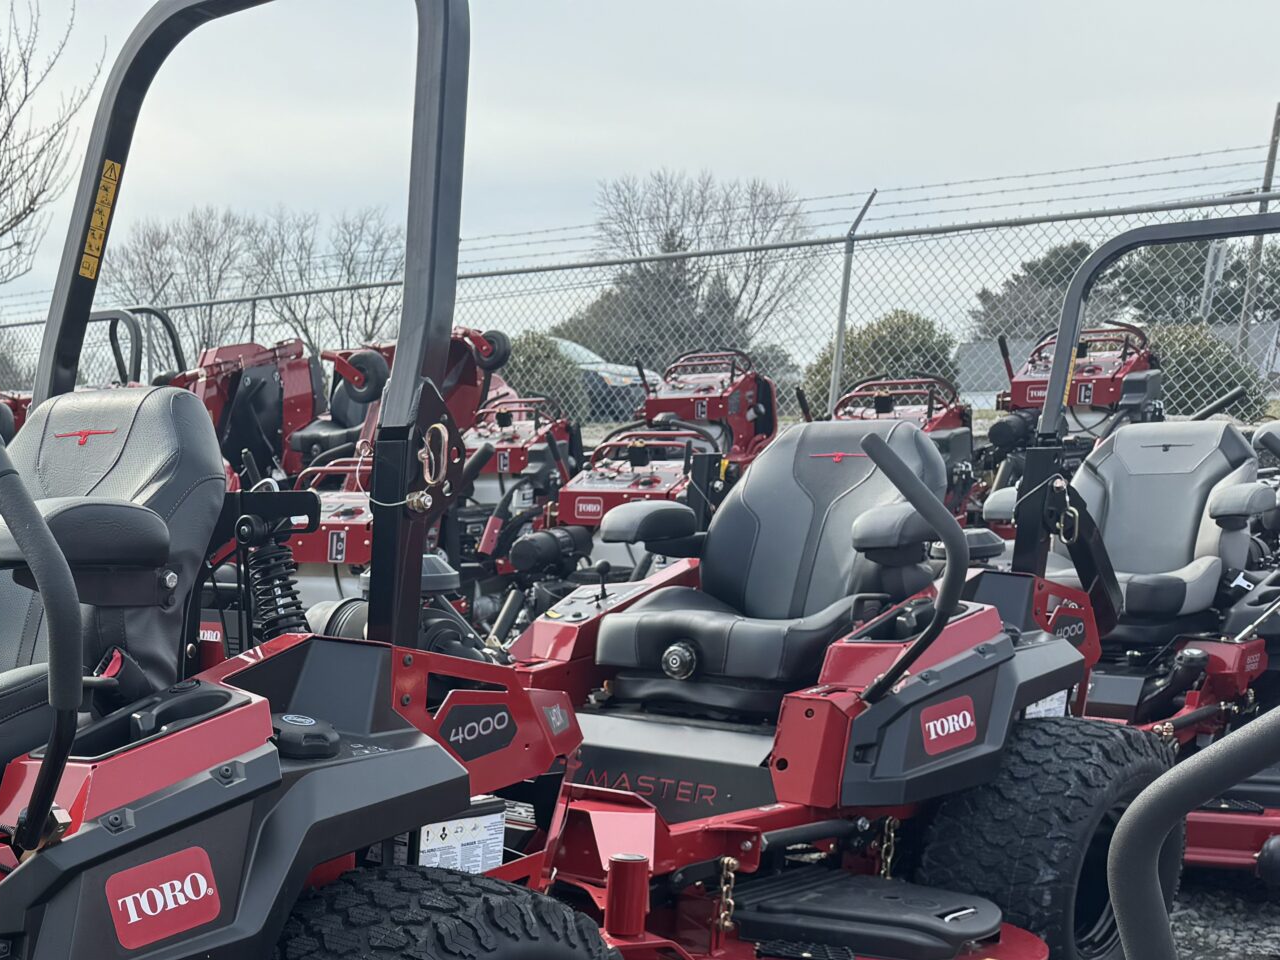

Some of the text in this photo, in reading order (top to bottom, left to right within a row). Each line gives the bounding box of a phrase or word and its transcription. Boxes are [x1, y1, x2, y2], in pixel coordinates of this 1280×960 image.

[578, 503, 601, 513] TORO
[199, 629, 221, 642] ORO
[1055, 621, 1084, 639] 4000
[449, 711, 509, 744] 4000
[925, 710, 972, 741] TORO
[117, 872, 208, 925] TORO
